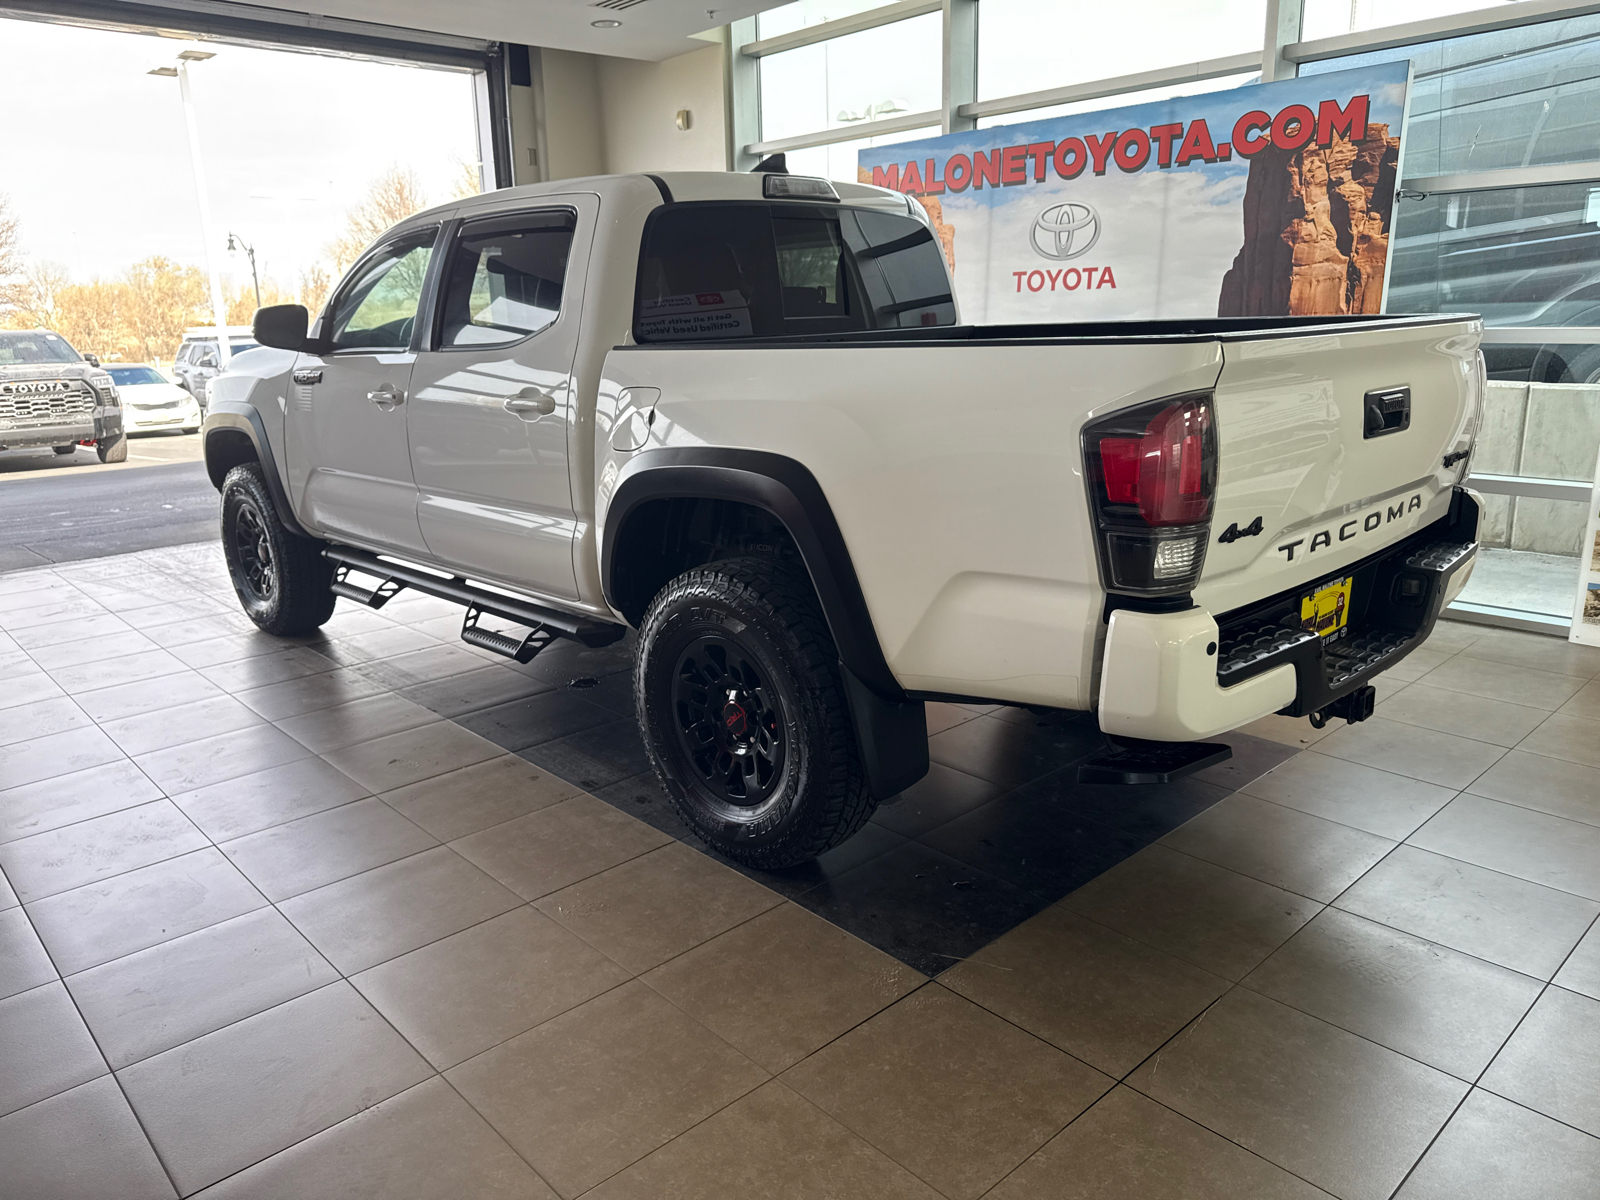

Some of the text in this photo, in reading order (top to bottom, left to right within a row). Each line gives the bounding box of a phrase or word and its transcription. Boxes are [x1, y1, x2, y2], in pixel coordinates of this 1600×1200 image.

[872, 94, 1370, 197] MALONETOYOTA.COM
[1012, 266, 1117, 294] TOYOTA
[9, 383, 65, 394] TOYOTA
[1278, 494, 1422, 562] TACOMA
